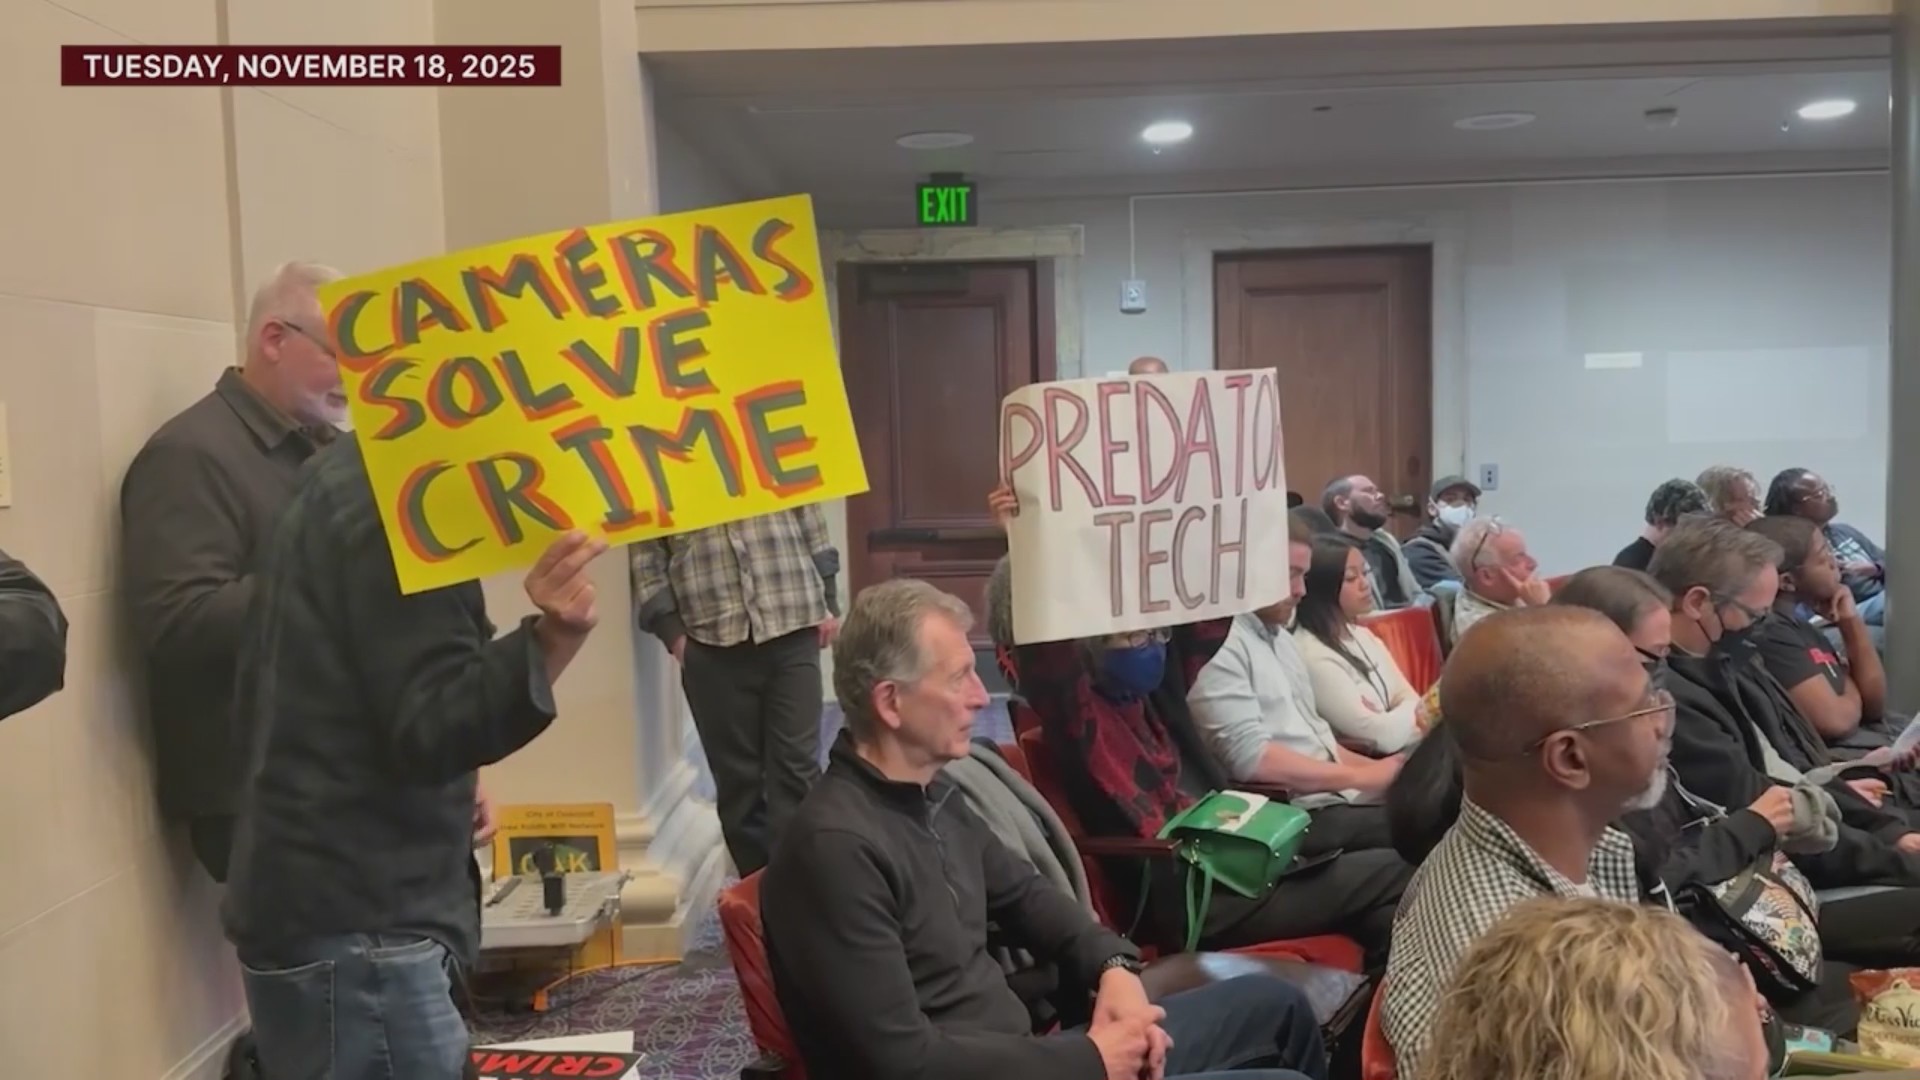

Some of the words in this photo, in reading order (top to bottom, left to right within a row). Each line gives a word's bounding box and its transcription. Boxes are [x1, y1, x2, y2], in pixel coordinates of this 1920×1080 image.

[922, 186, 971, 223] EXIT
[328, 217, 815, 373] CAMERAS
[359, 307, 719, 441] SOLVE
[396, 380, 825, 564] CRIME
[1093, 498, 1248, 617] TECH
